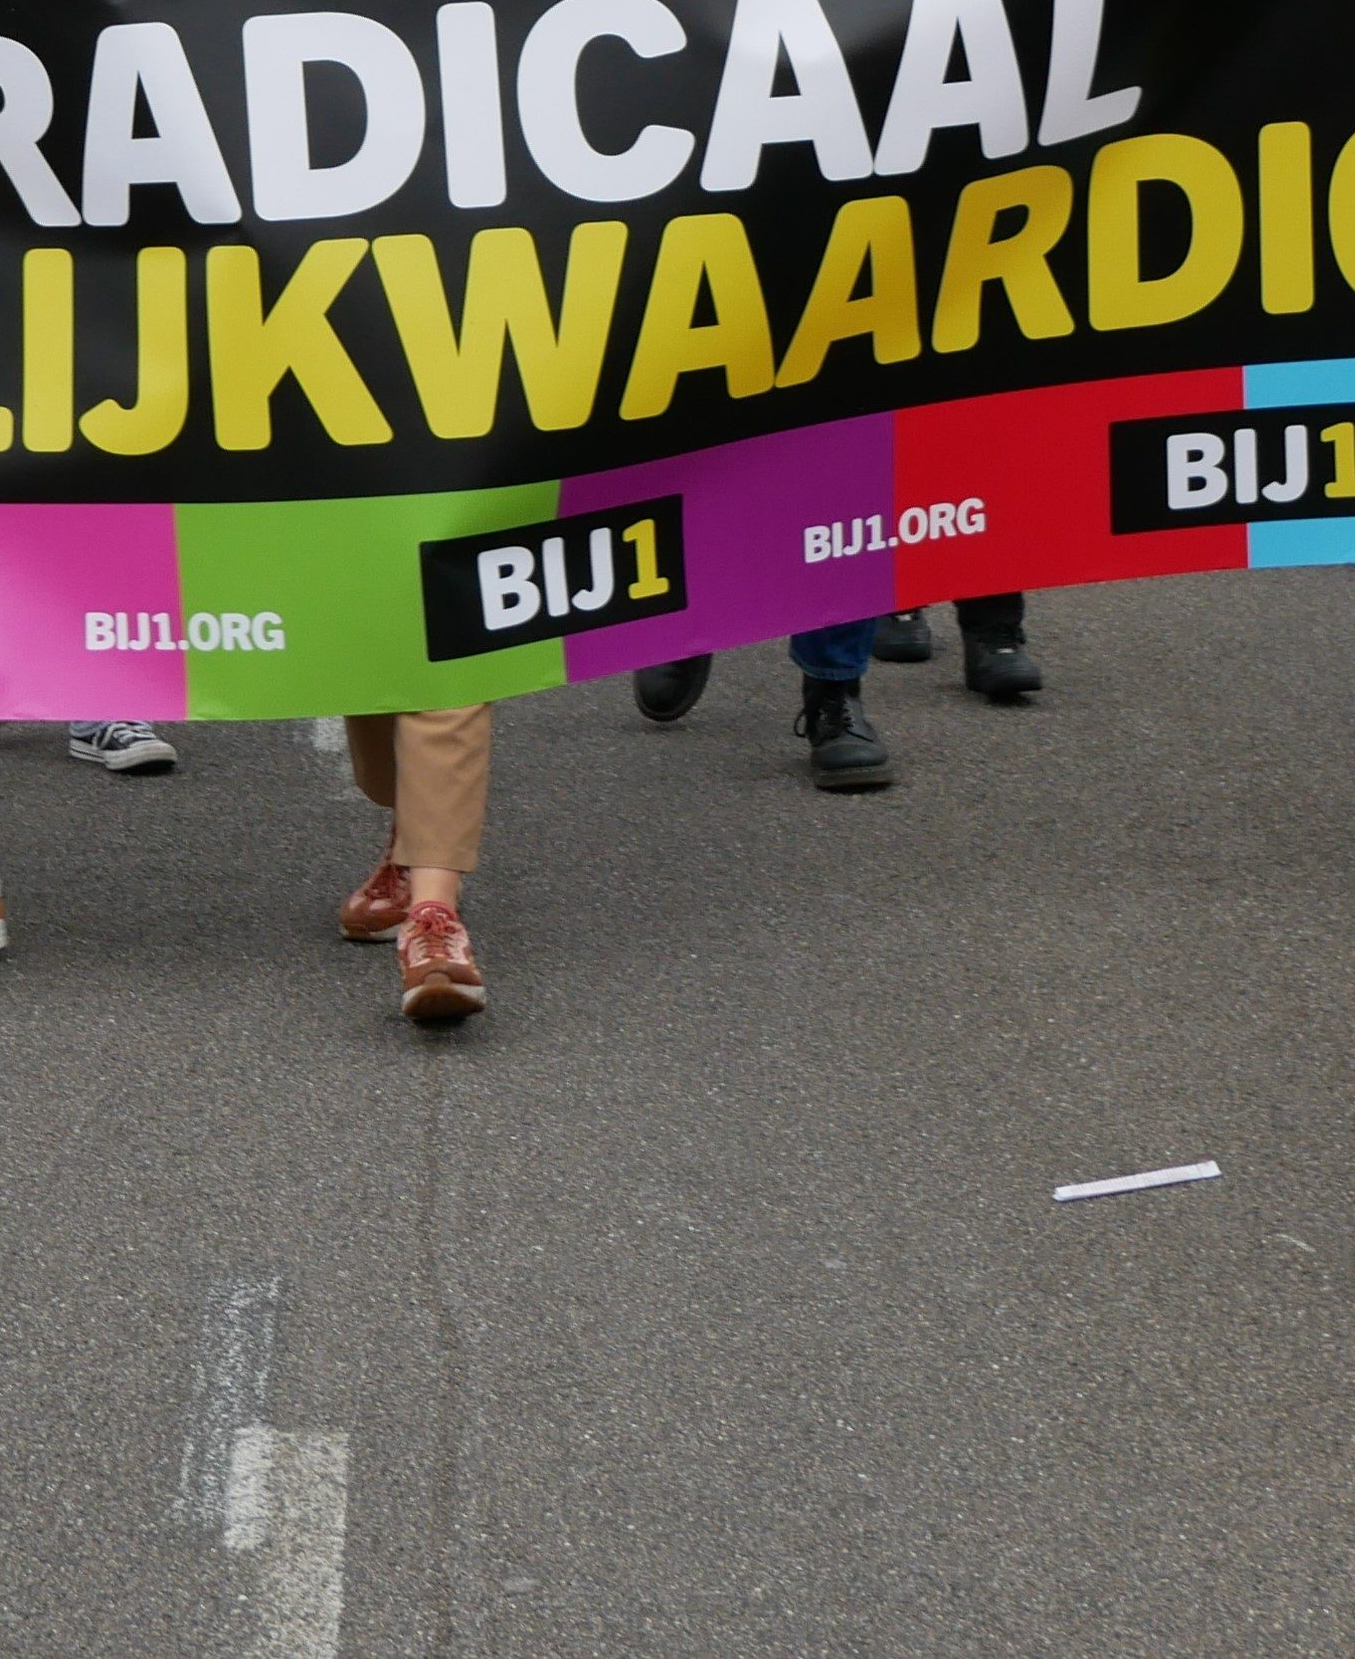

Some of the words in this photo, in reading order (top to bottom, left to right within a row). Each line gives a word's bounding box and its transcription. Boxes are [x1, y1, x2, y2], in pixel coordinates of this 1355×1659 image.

[803, 499, 987, 565] BIJ1.ORG
[477, 520, 670, 632] BIJ1
[85, 612, 285, 652] BIJ1.ORG
